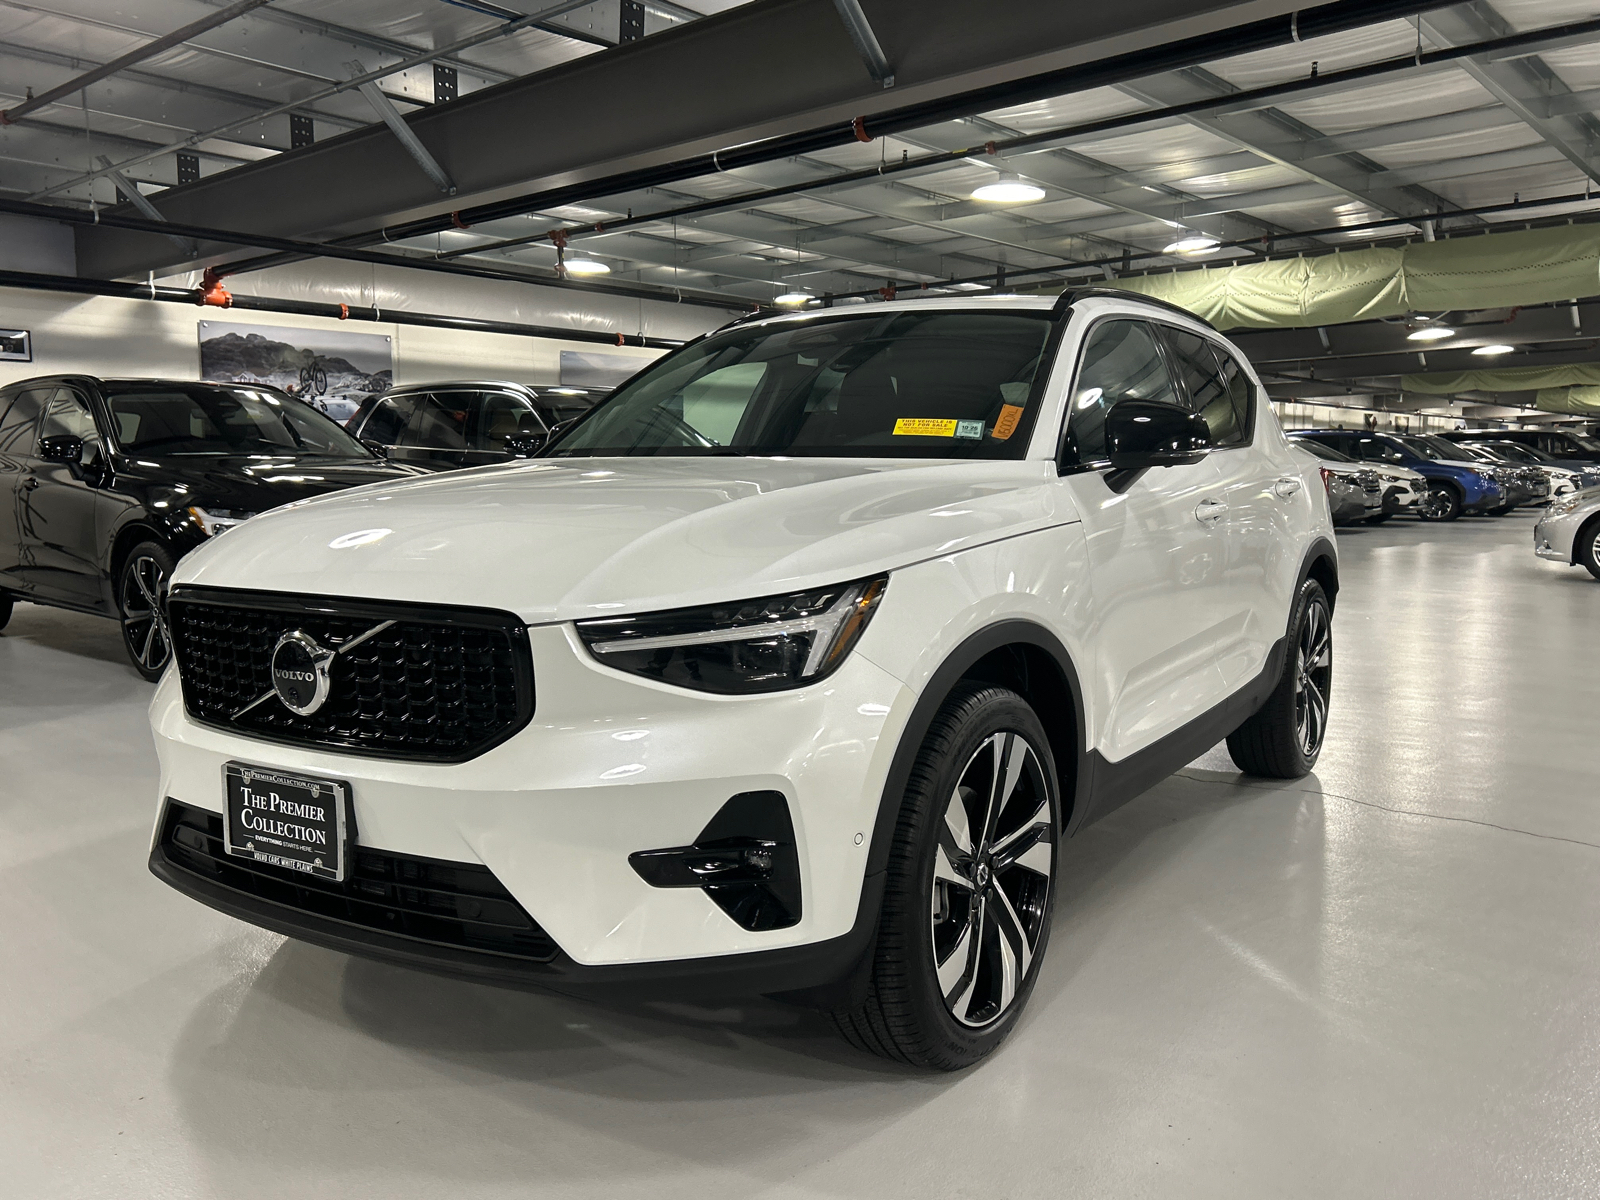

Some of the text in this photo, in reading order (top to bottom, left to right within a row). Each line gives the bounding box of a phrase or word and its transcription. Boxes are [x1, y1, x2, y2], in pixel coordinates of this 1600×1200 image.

[275, 668, 315, 682] VOLVO
[241, 787, 325, 822] THE PREMIER
[241, 808, 326, 845] COLLECTION
[255, 835, 283, 846] EVERYTHING
[283, 841, 299, 850] STARTS
[254, 852, 313, 873] VOLVO CARS WHITE PLAINS
